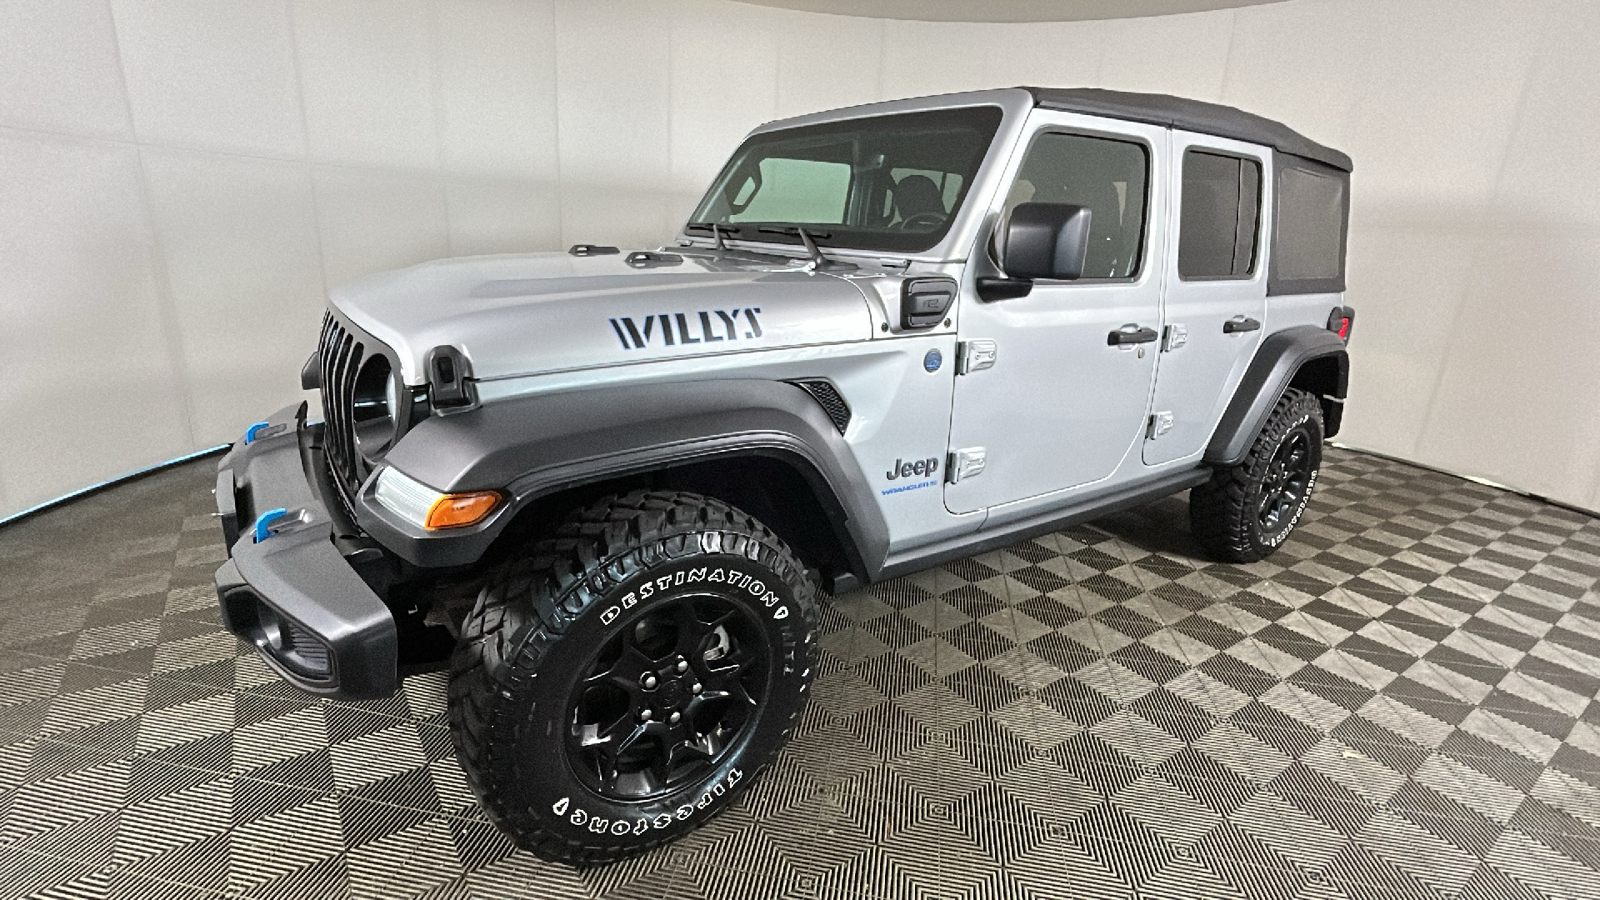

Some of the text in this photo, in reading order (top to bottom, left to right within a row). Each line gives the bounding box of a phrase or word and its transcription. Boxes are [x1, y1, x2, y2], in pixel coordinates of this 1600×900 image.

[609, 308, 762, 349] WILLYS
[886, 457, 939, 481] Jeep
[600, 568, 779, 625] DESTINATION
